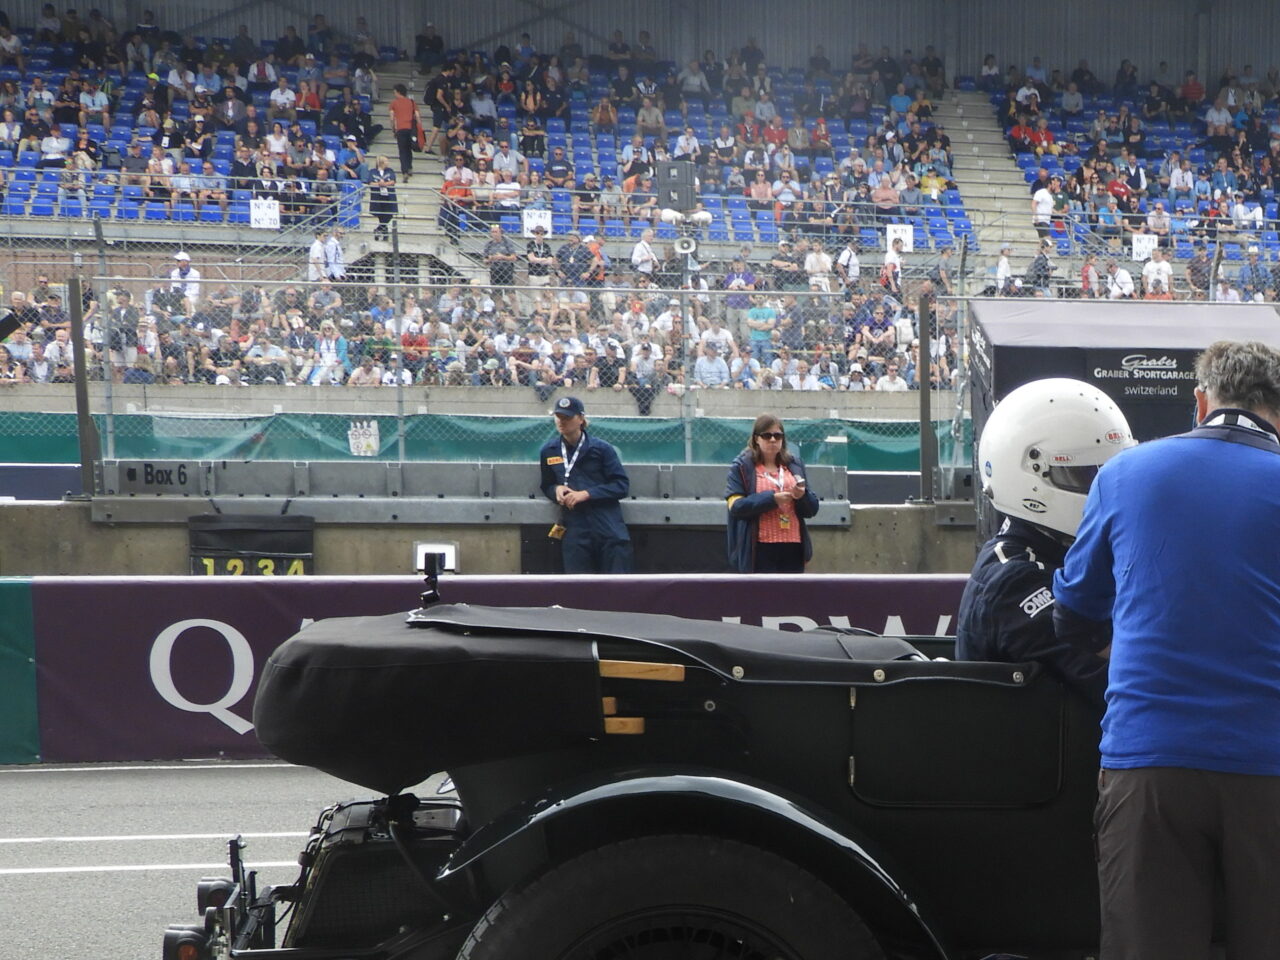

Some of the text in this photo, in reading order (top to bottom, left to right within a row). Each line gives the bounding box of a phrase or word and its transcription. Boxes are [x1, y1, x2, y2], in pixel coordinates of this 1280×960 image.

[1094, 368, 1129, 378] GRABER
[1133, 369, 1194, 380] SPORTGARAGE
[1124, 385, 1178, 396] switzerland
[1107, 432, 1125, 441] BELL
[144, 463, 188, 486] Box 6
[1023, 589, 1053, 615] OMP
